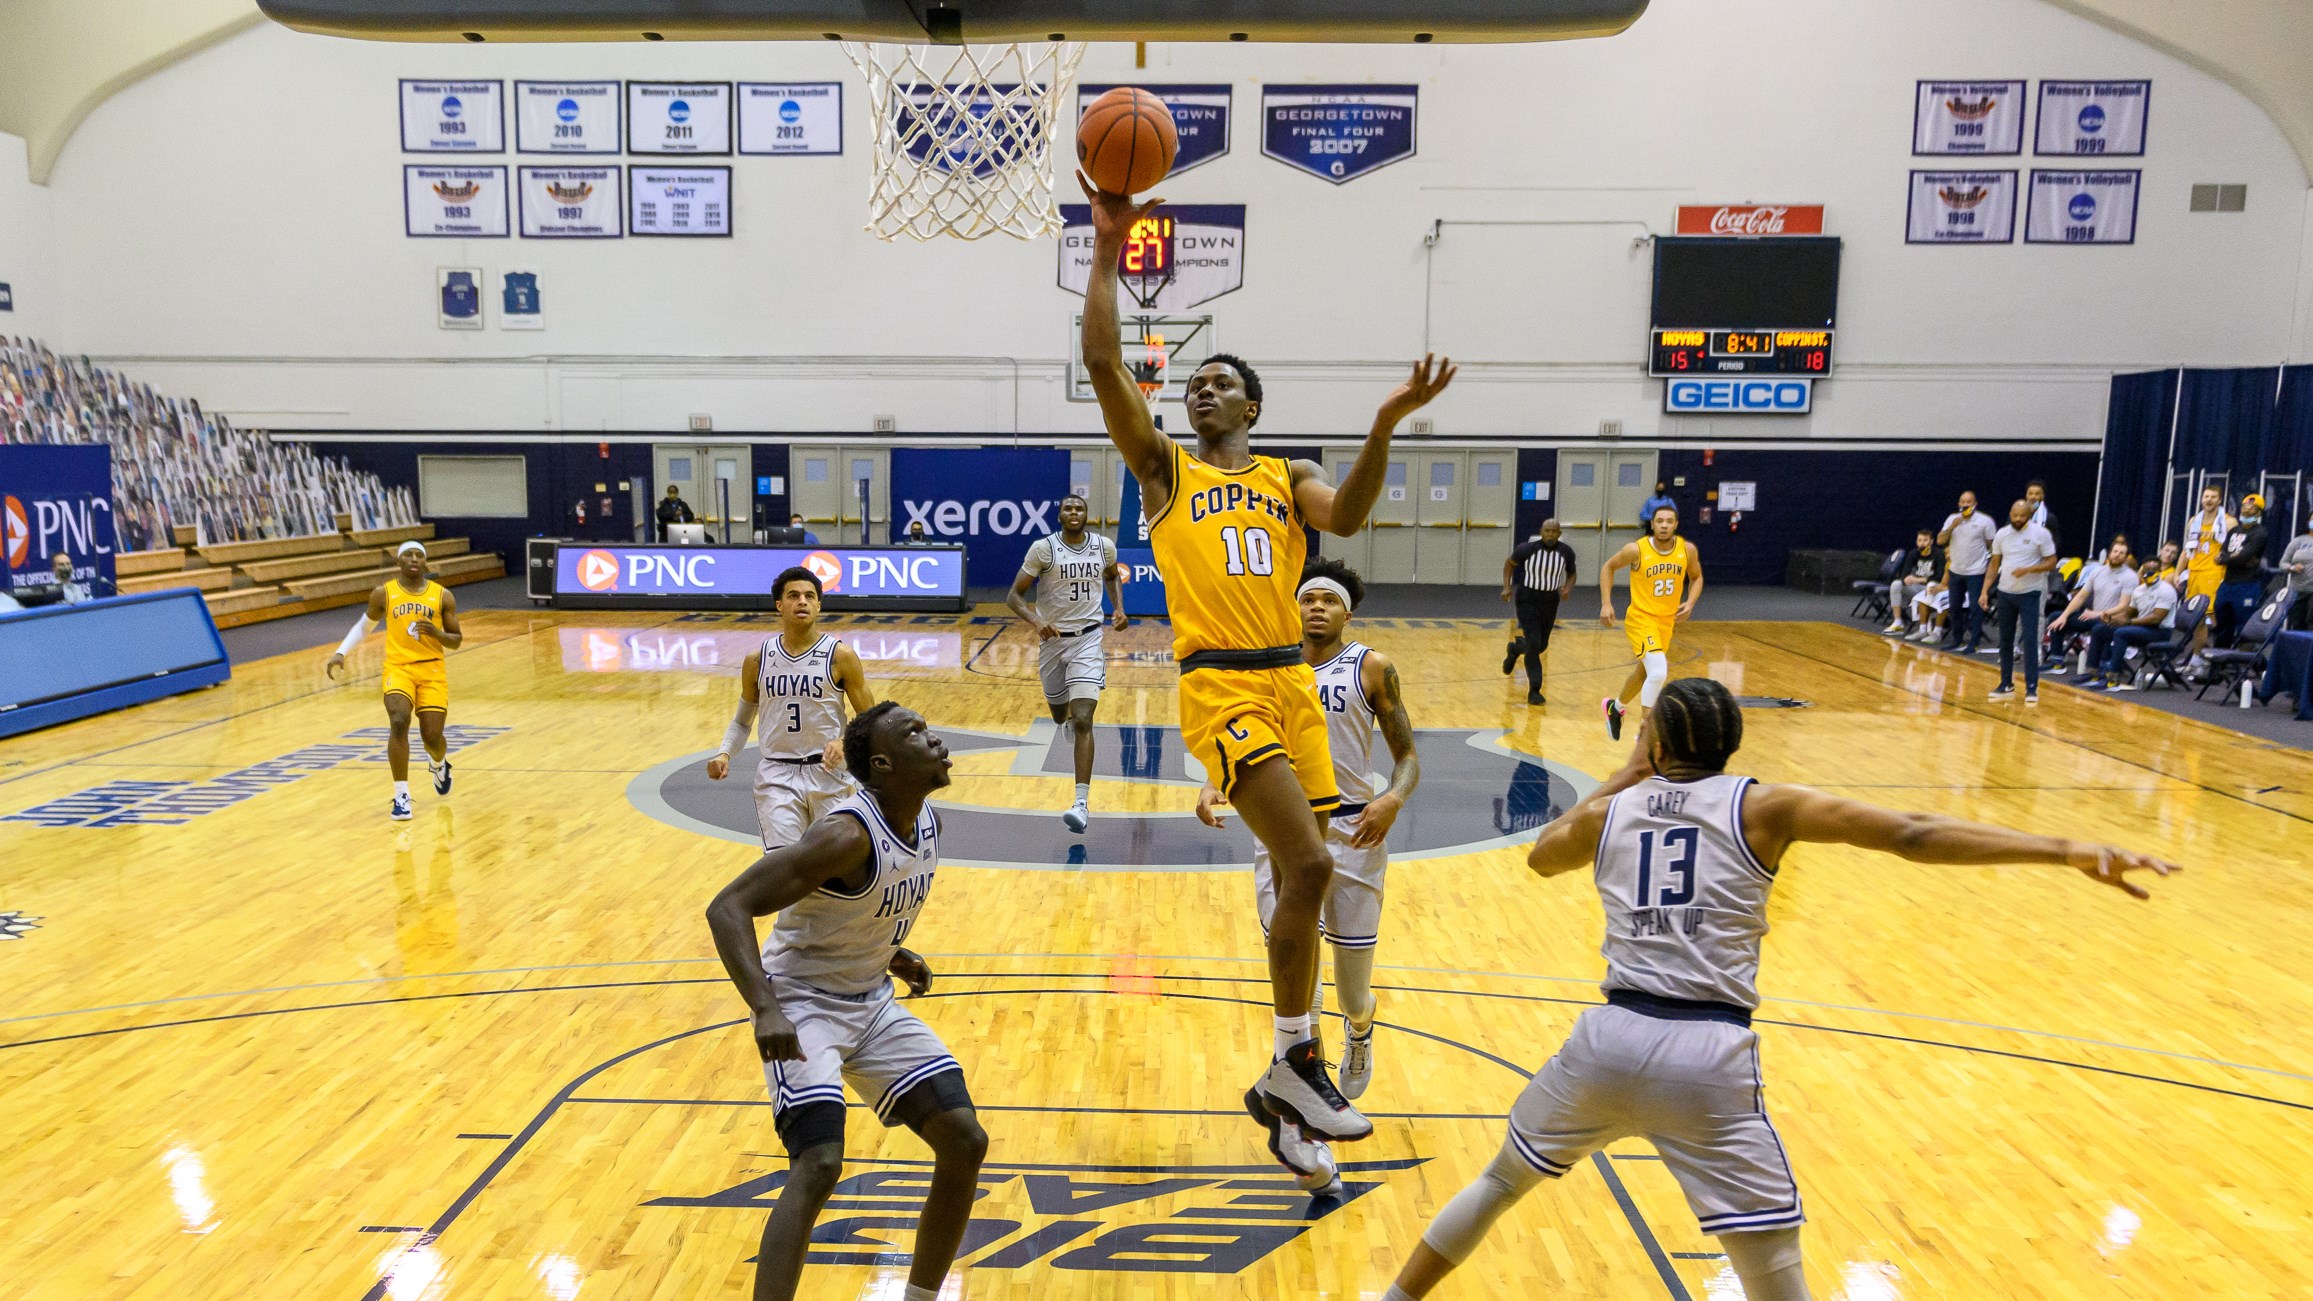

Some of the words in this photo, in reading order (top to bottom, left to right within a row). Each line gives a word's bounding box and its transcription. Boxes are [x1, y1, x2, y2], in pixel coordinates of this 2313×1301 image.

[1276, 110, 1402, 120] GEORGETOWN
[554, 125, 583, 138] 2010
[665, 125, 693, 139] 2011
[776, 125, 804, 139] 2012
[1292, 128, 1336, 136] FINAL
[1344, 128, 1384, 136] FOUR
[1310, 140, 1368, 153] 2007
[1126, 238, 1163, 271] 27
[1662, 331, 1705, 346] HOYAS
[1727, 333, 1770, 353] 8:41
[1671, 351, 1688, 369] 15
[1718, 361, 1744, 370] PERIOD
[1806, 351, 1824, 370] 18
[1671, 383, 1806, 408] GEICO
[1414, 422, 1428, 432] EXIT
[1603, 423, 1616, 433] EXIT
[1190, 483, 1289, 527] COPPIN
[902, 500, 1052, 535] xerox
[33, 498, 111, 560] PNC
[1220, 526, 1273, 576] 10
[86, 566, 96, 579] TH
[628, 554, 716, 588] PNC
[848, 556, 939, 590] PNC
[1060, 563, 1100, 579] HOYAS
[1134, 565, 1163, 582] PN
[1646, 563, 1683, 578] COPPIN
[1069, 581, 1091, 601] 34
[1653, 579, 1675, 597] 25
[392, 602, 435, 620] COPPIN
[765, 674, 824, 698] HOYAS
[786, 703, 801, 733] 3
[1225, 718, 1250, 742] C
[82, 742, 389, 829] THOMPSON
[0, 781, 196, 828] JOHN
[1646, 791, 1691, 818] CAREY
[1637, 826, 1701, 908] 13
[1630, 909, 1673, 938] SPEAK
[1683, 908, 1704, 936] UP
[640, 1168, 1385, 1221] EAST
[743, 1216, 1313, 1274] BIG
